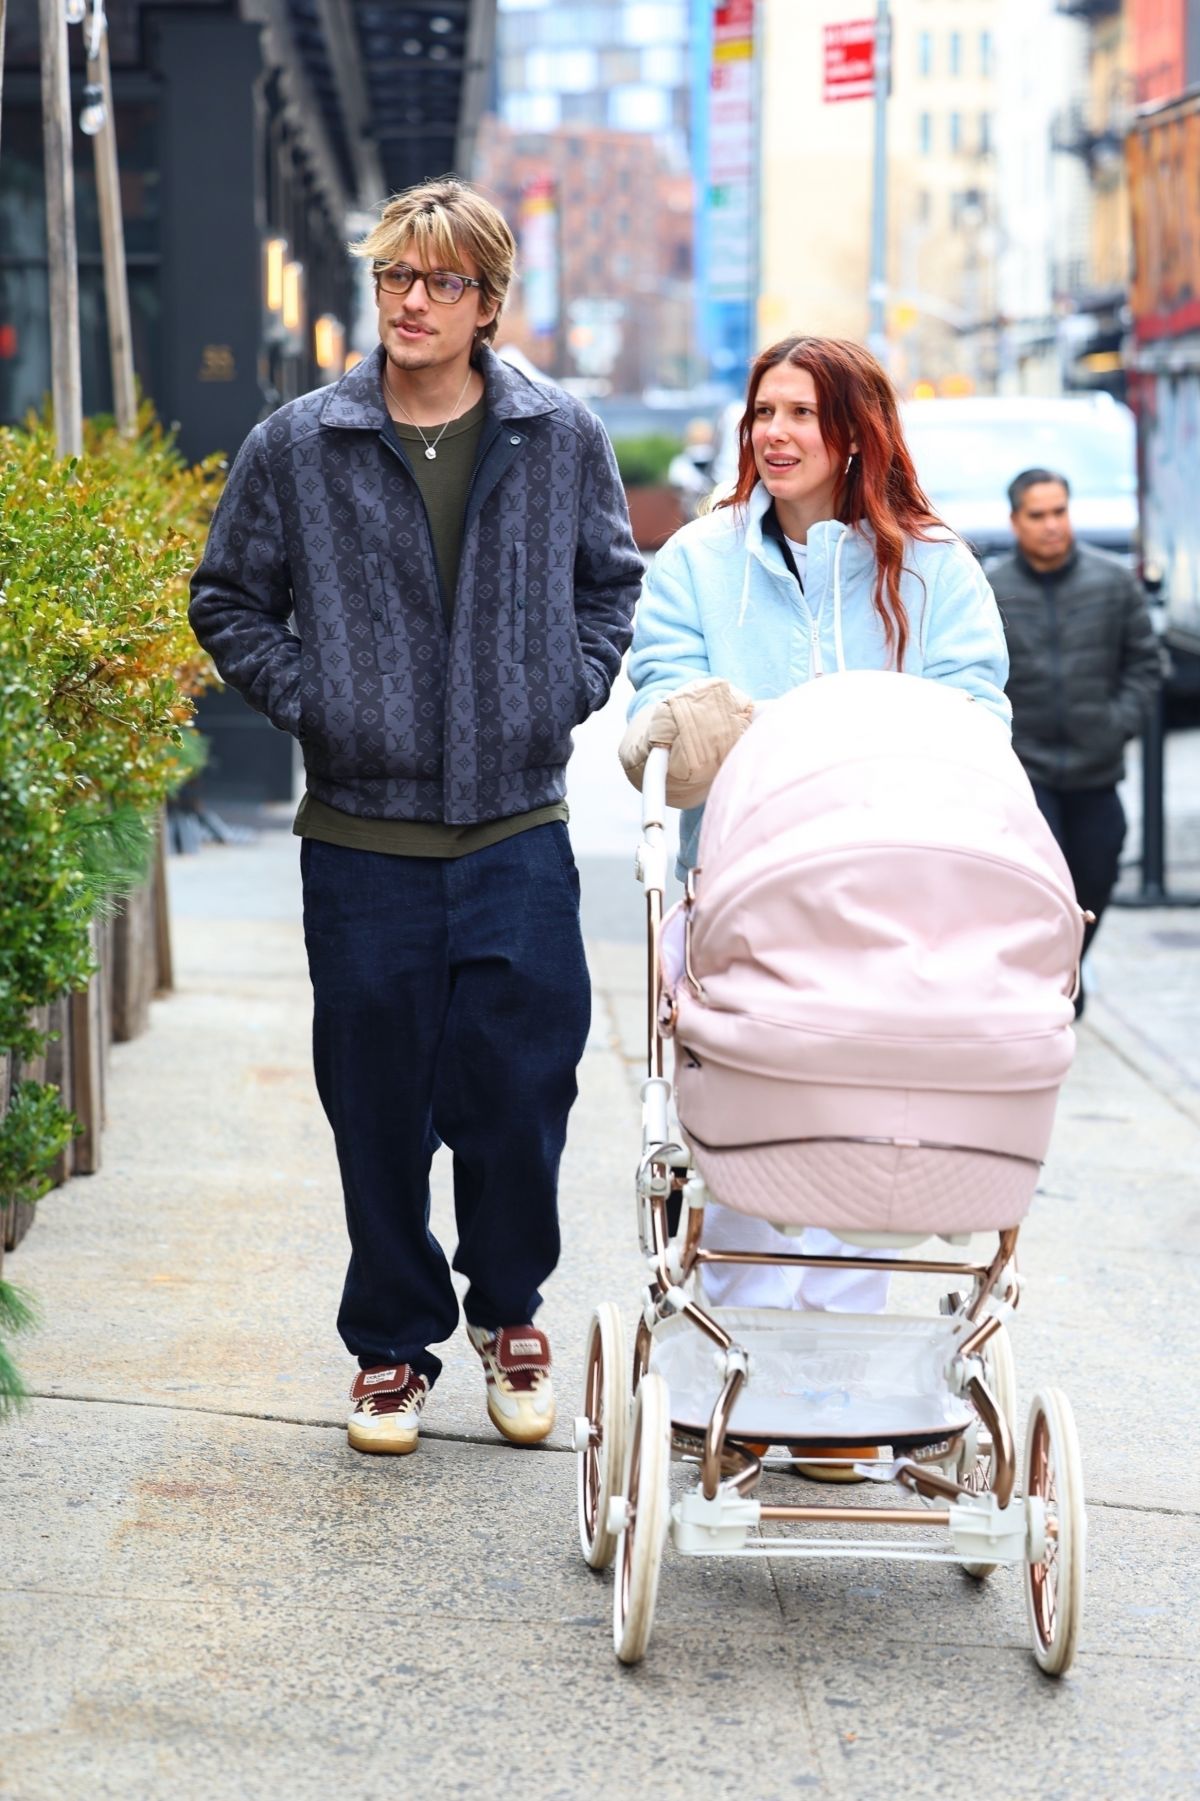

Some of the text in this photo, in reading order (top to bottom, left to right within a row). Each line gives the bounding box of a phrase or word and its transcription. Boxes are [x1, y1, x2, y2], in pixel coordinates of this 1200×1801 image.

[556, 433, 572, 452] LV
[504, 491, 522, 512] LV
[555, 490, 570, 511] LV
[304, 505, 324, 525] LV
[361, 503, 381, 523] LV
[552, 549, 569, 568] LV
[312, 563, 332, 583] LV
[551, 606, 568, 626] LV
[322, 621, 341, 641] LV
[389, 674, 408, 694] LV
[503, 665, 520, 684] LV
[552, 664, 569, 684] LV
[328, 678, 347, 699] LV
[508, 722, 527, 742] LV
[391, 732, 409, 753] LV
[915, 1441, 949, 1459] STYLO
